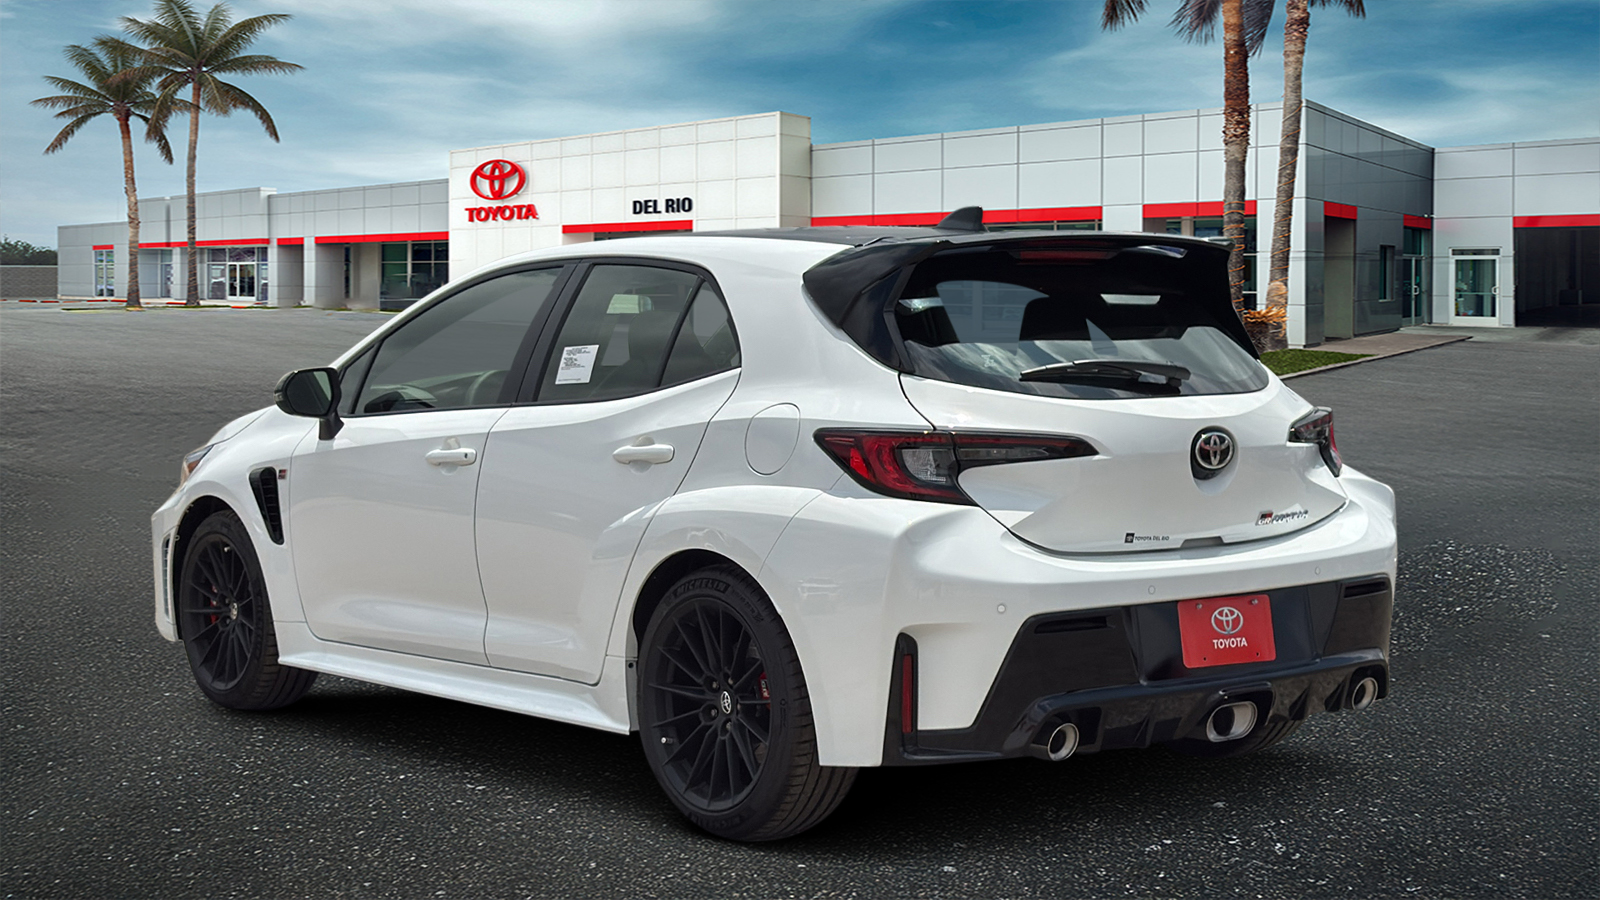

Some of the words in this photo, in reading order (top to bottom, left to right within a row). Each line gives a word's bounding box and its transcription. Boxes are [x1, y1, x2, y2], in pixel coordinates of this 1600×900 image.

[465, 204, 538, 222] TOYOTA
[632, 200, 661, 214] DEL
[665, 197, 693, 213] RIO
[675, 579, 728, 595] MICHELIN
[1212, 637, 1248, 649] TOYOTA
